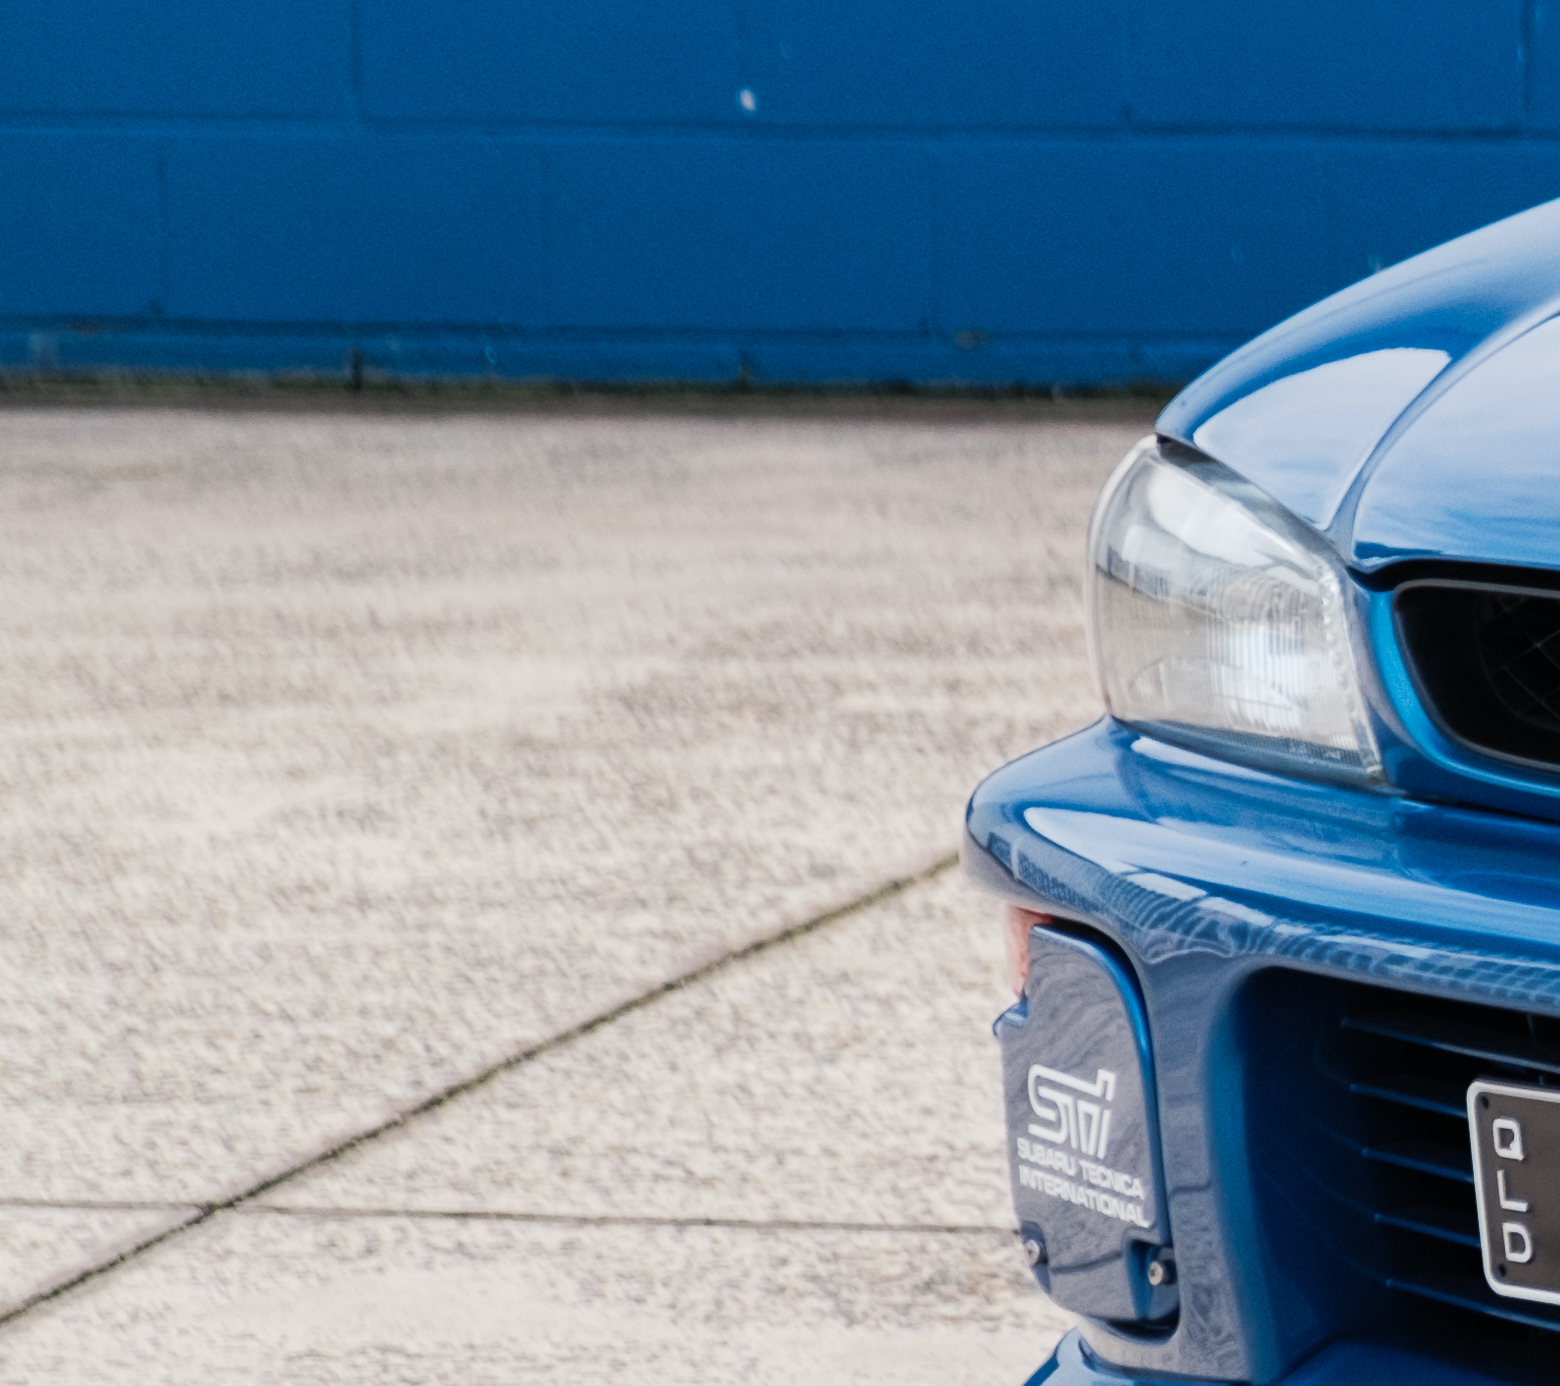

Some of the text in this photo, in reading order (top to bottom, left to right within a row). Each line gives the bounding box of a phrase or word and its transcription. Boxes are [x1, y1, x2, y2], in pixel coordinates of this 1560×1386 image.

[1016, 1136, 1145, 1201] SUBARU TECNICA
[1018, 1165, 1155, 1229] INTERNATIONAL
[1492, 1118, 1533, 1264] QLD
